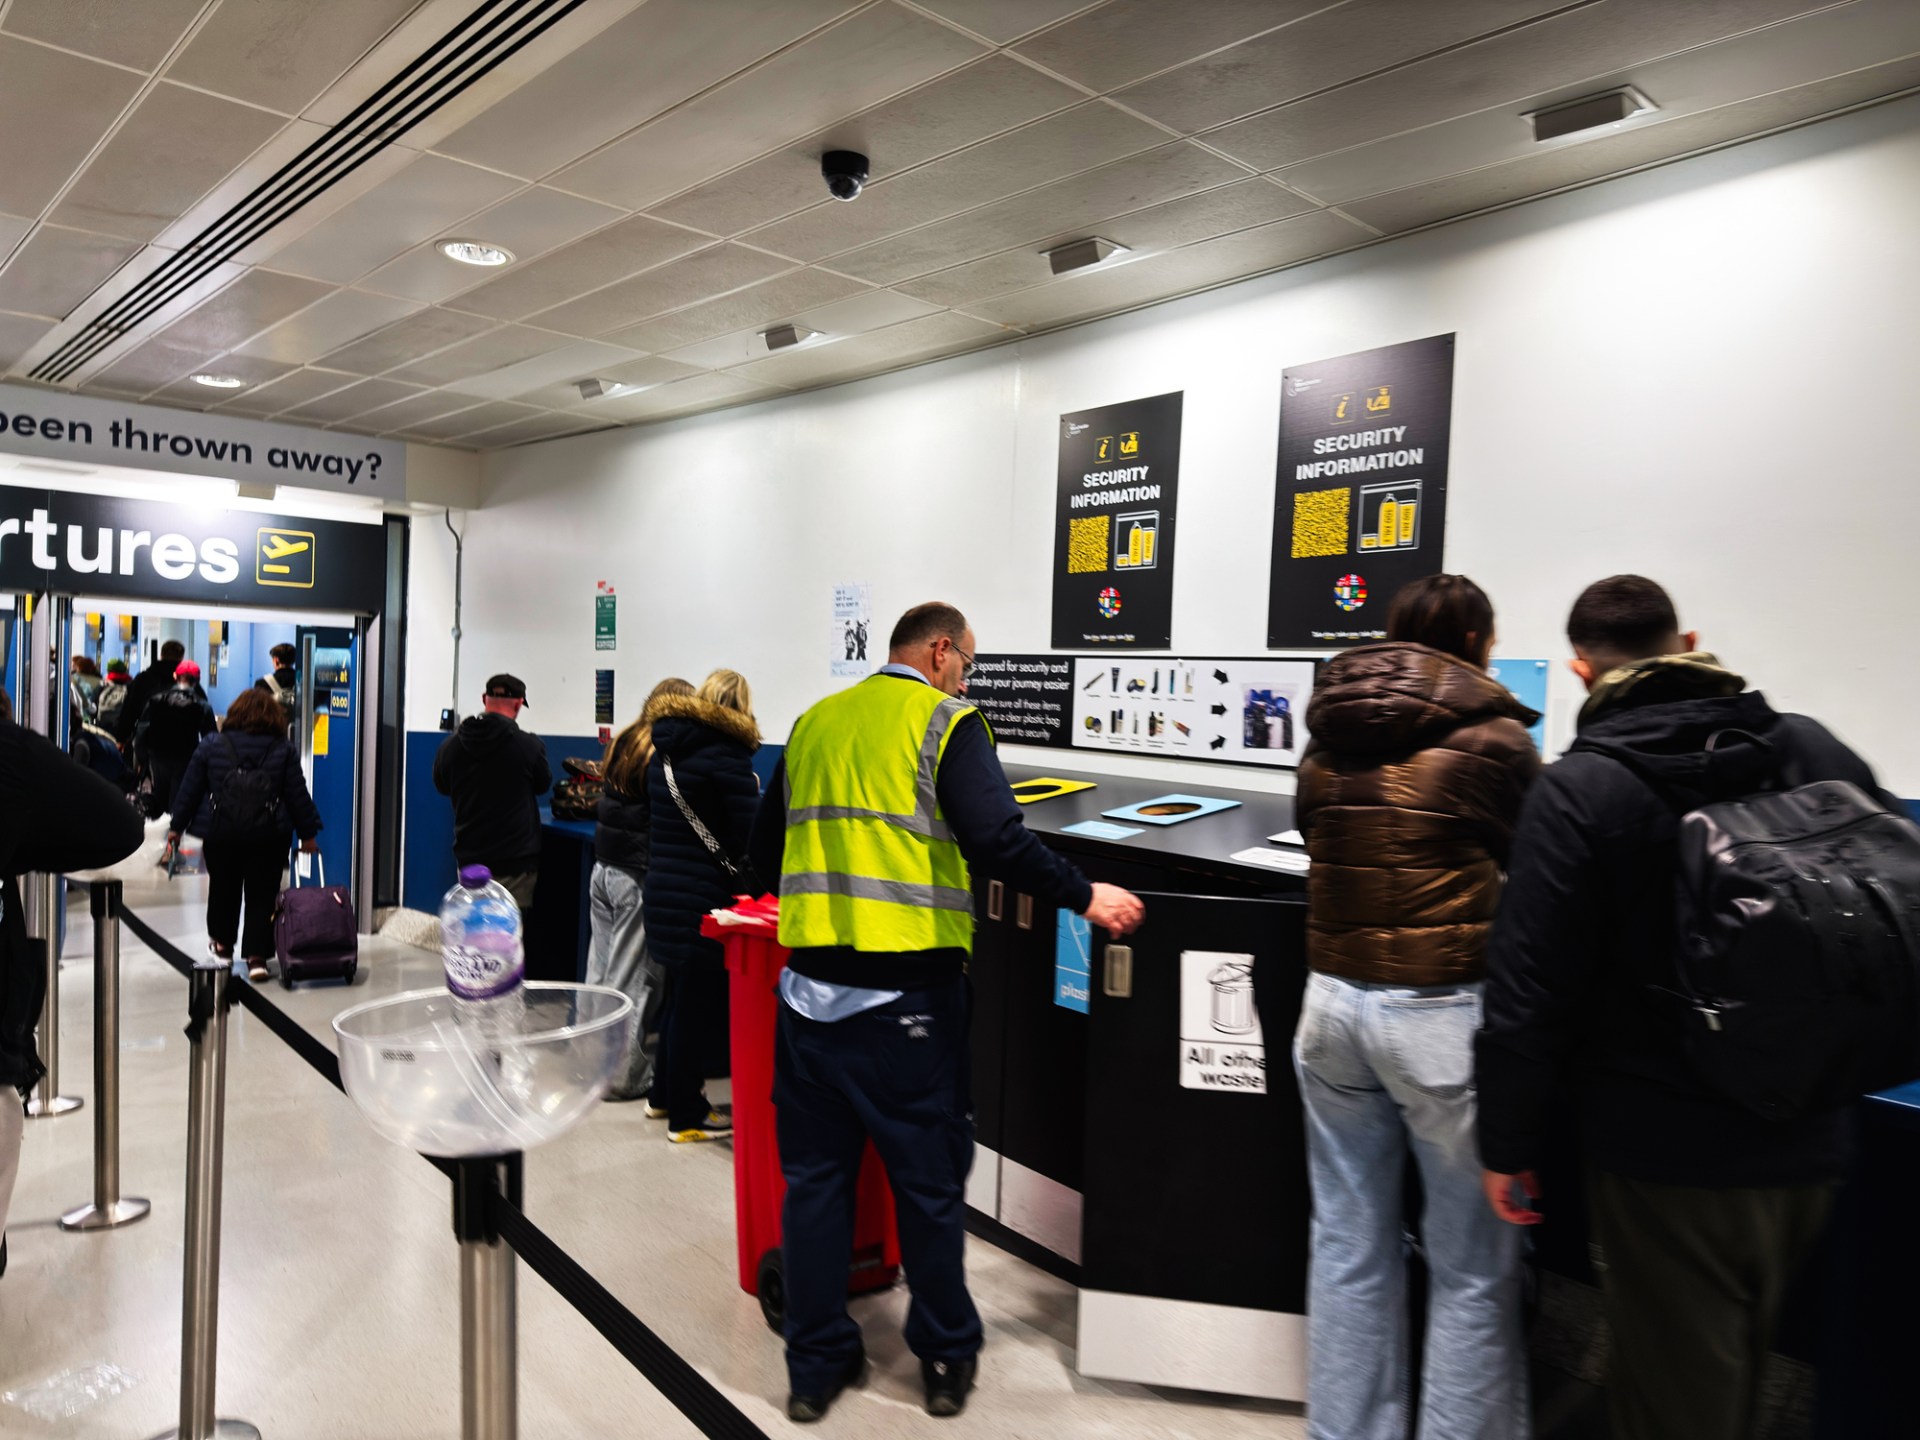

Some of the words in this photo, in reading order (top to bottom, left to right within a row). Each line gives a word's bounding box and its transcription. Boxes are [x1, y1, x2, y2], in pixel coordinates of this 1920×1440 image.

[1312, 425, 1407, 454] SECURITY
[109, 418, 252, 464] thrown
[267, 449, 382, 484] away?
[1296, 447, 1424, 480] INFORMATION
[1083, 465, 1149, 488] SECURITY
[1071, 484, 1161, 509] INFORMATION
[1007, 660, 1018, 672] for
[1019, 660, 1050, 676] security
[1050, 660, 1069, 674] and
[971, 675, 993, 687] make
[993, 679, 1011, 690] your
[1011, 676, 1043, 692] journey
[1043, 678, 1070, 690] easier
[981, 697, 998, 708] make
[1023, 699, 1041, 711] these
[1041, 700, 1062, 712] items
[1023, 712, 1045, 725] plastic
[1045, 713, 1061, 728] bag
[1025, 728, 1051, 741] security
[1185, 1047, 1215, 1066] All
[1199, 1072, 1264, 1089] waste
